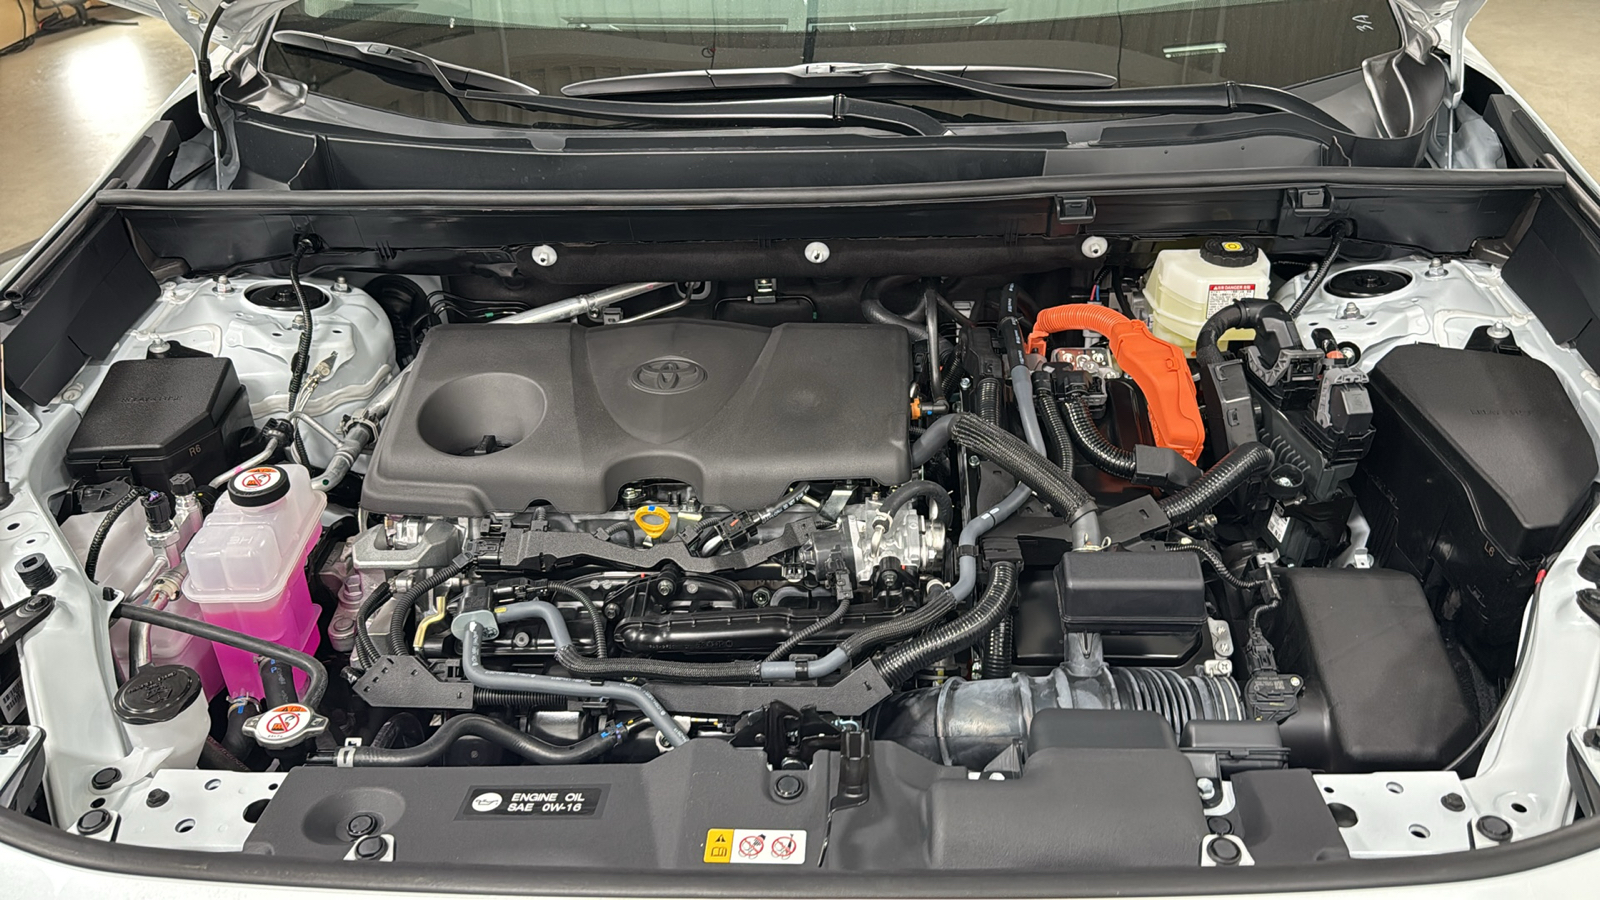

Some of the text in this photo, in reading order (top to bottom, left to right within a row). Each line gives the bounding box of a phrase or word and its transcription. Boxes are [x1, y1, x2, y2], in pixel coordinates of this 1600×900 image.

[188, 444, 202, 457] R6
[1484, 540, 1495, 557] L6
[511, 793, 585, 802] ENGINE OIL
[507, 803, 582, 812] SAE 0W-16
